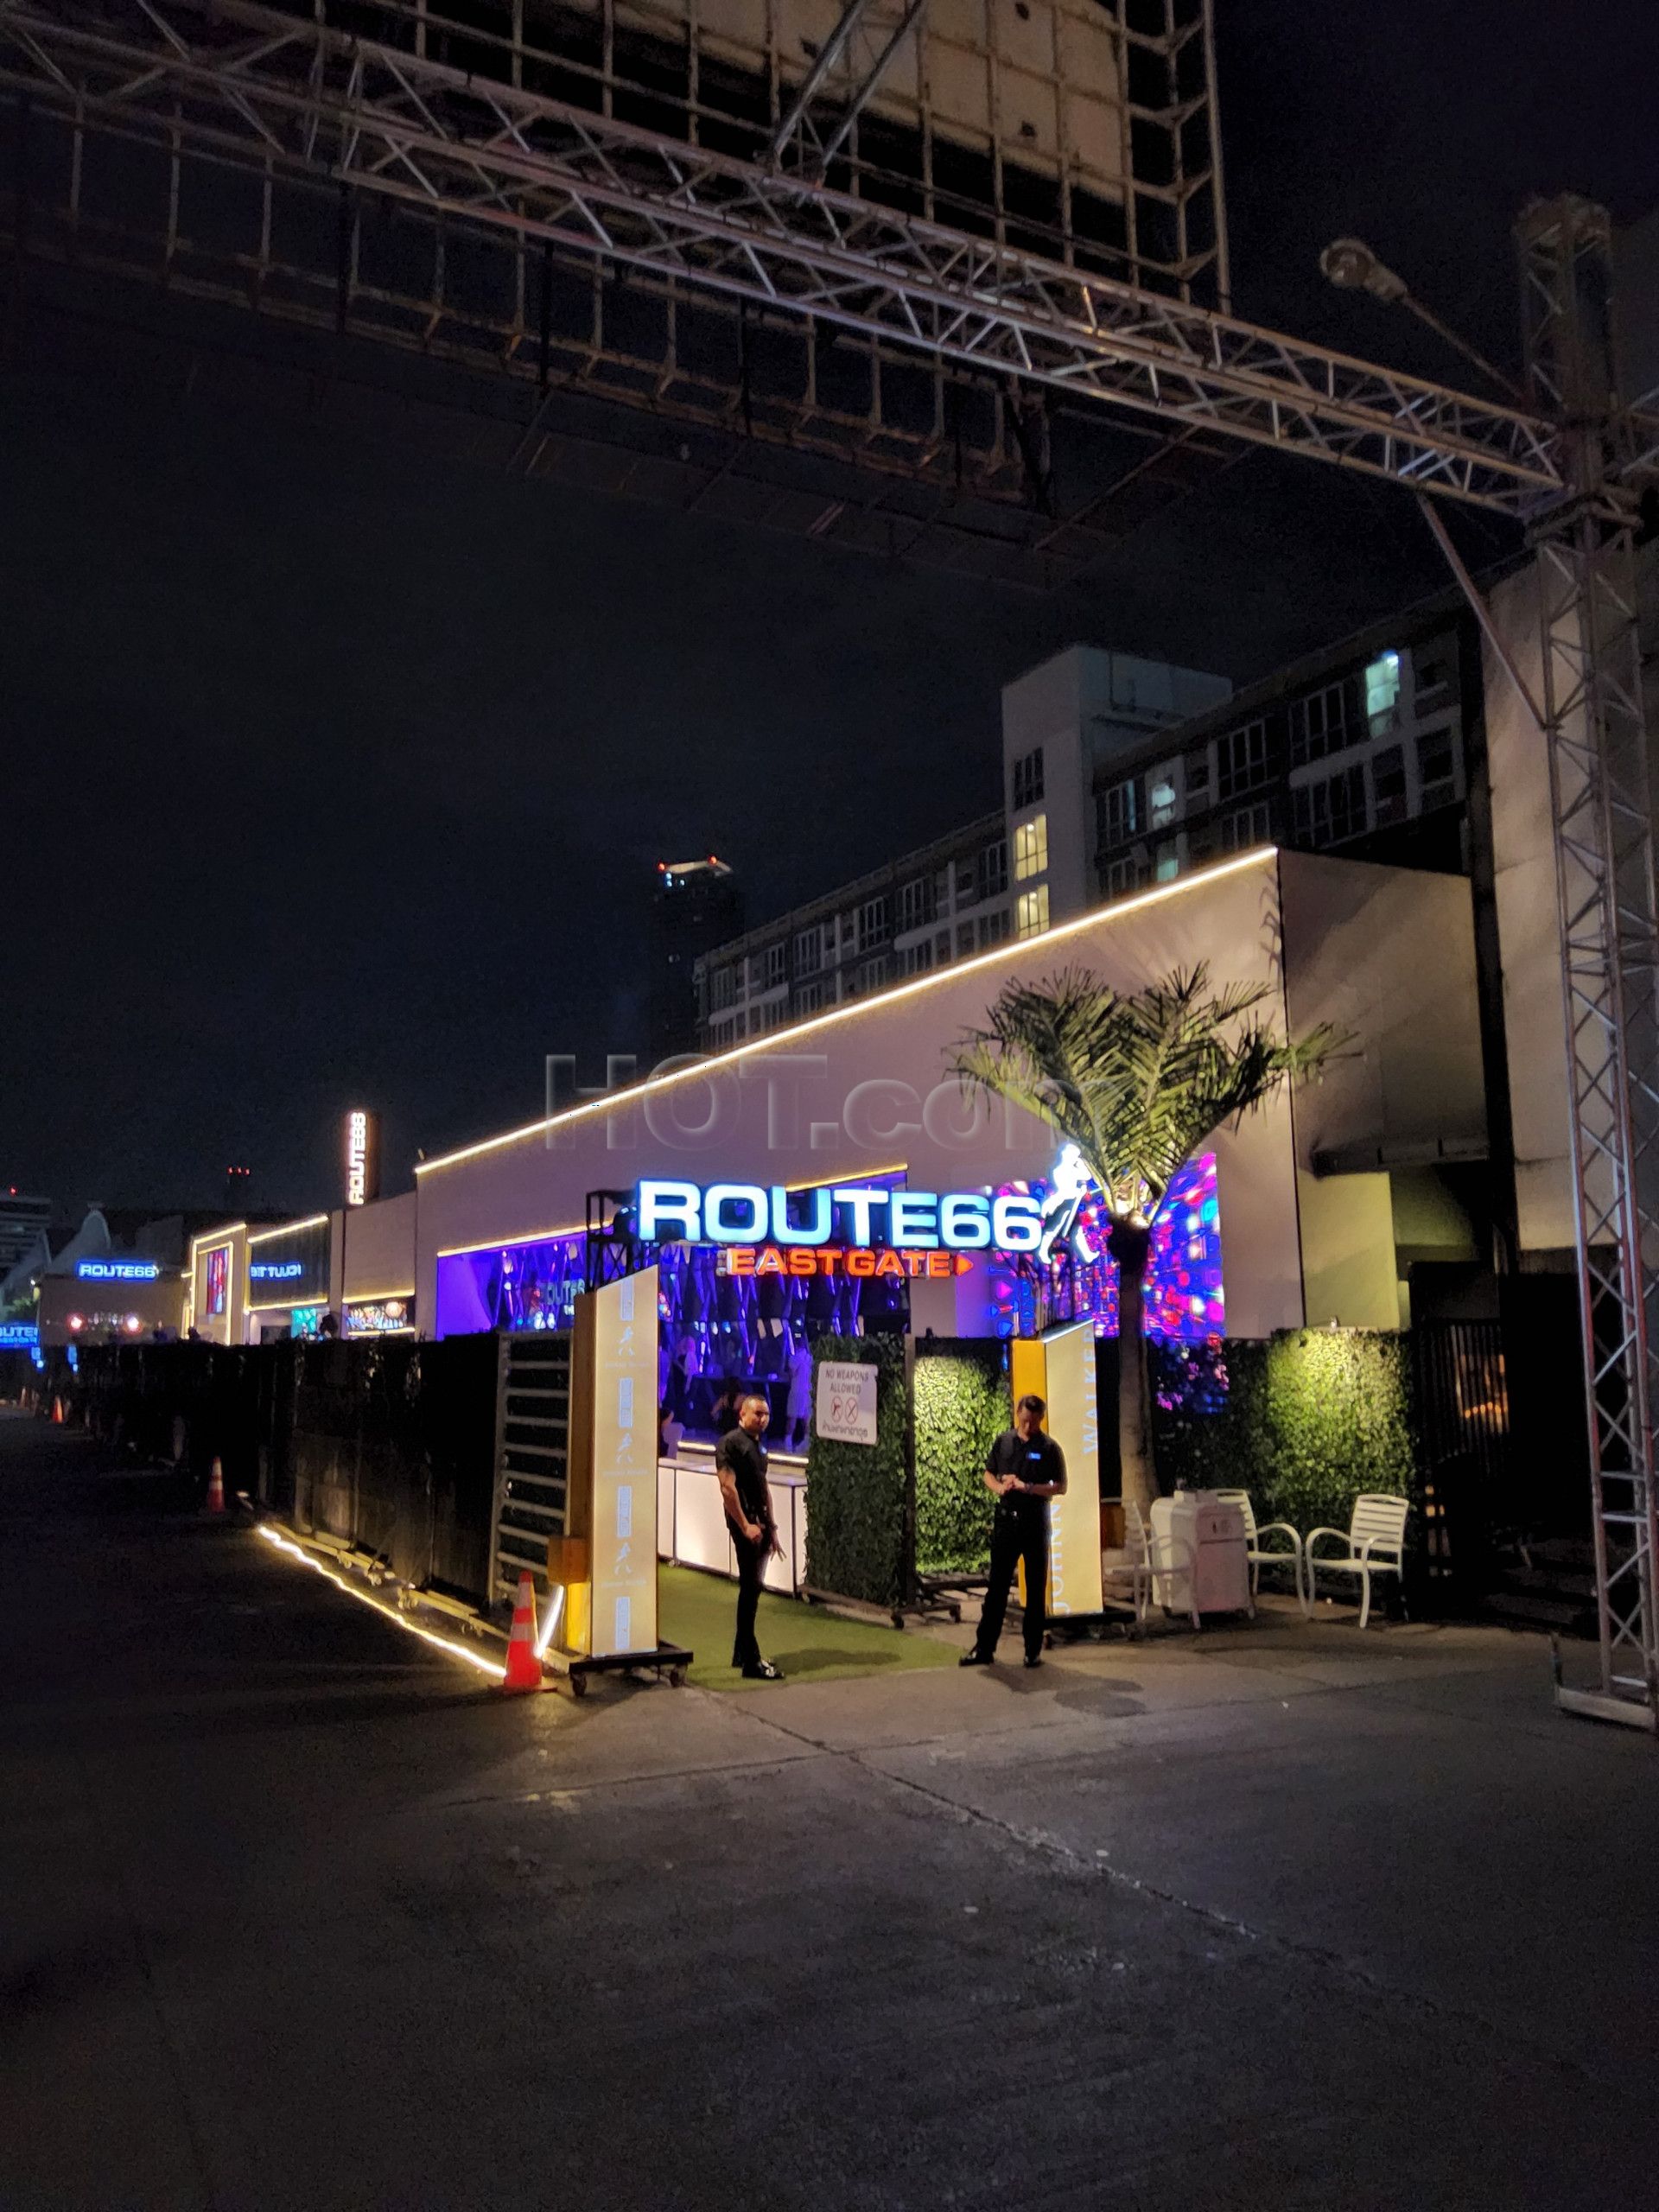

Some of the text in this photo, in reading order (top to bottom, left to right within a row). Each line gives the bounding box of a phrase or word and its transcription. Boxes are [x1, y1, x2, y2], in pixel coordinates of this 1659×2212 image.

[639, 1179, 1043, 1251] ROUTE66
[79, 1262, 156, 1279] ROUTE66
[727, 1247, 951, 1277] EAST GATE
[825, 1368, 869, 1382] NO WEAPONS
[830, 1382, 861, 1395] ALLOWED
